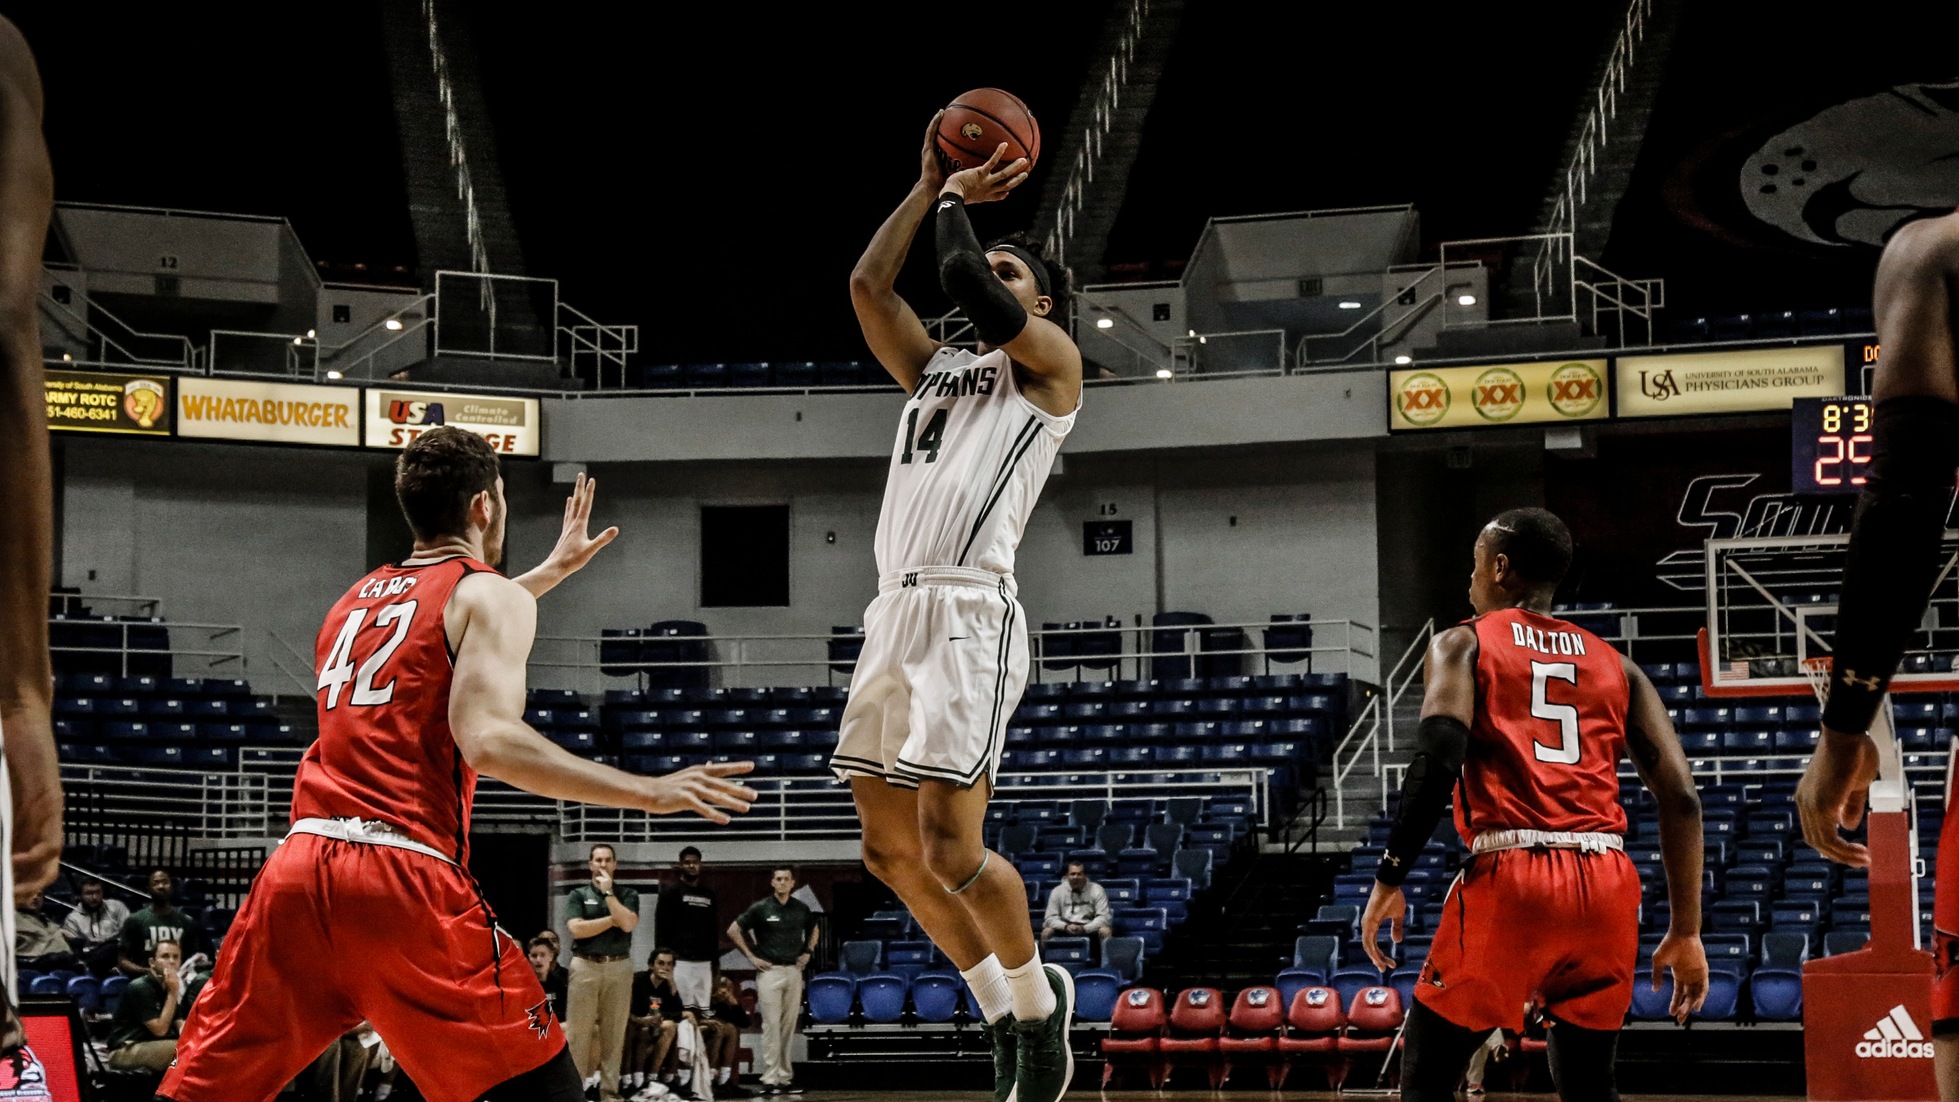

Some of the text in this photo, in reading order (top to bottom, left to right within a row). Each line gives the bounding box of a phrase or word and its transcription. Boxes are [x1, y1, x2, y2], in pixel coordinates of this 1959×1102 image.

[160, 256, 177, 268] 12
[1685, 370, 1732, 380] UNIVERSITY
[1746, 368, 1775, 376] SOUTH
[1777, 366, 1819, 375] ALABAMA
[1685, 375, 1824, 392] PHYSICIANS GROUP
[1479, 383, 1519, 406] XX
[1553, 378, 1595, 402] XX
[1638, 369, 1681, 401] USA
[80, 393, 117, 406] ROTC
[463, 405, 509, 415] Climate
[1404, 388, 1444, 411] XX
[46, 405, 117, 420] 51-460-6341
[181, 394, 349, 428] WHATABURGER
[388, 400, 445, 426] USA
[455, 413, 518, 425] Controlled
[388, 428, 517, 452] STGE
[900, 408, 948, 465] 14
[1101, 503, 1117, 516] 15
[1095, 540, 1120, 552] 107
[902, 572, 919, 588] JU
[1510, 621, 1586, 656] DALTON
[317, 599, 418, 712] 42
[1530, 659, 1582, 765] 5
[1855, 1038, 1935, 1058] adidas
